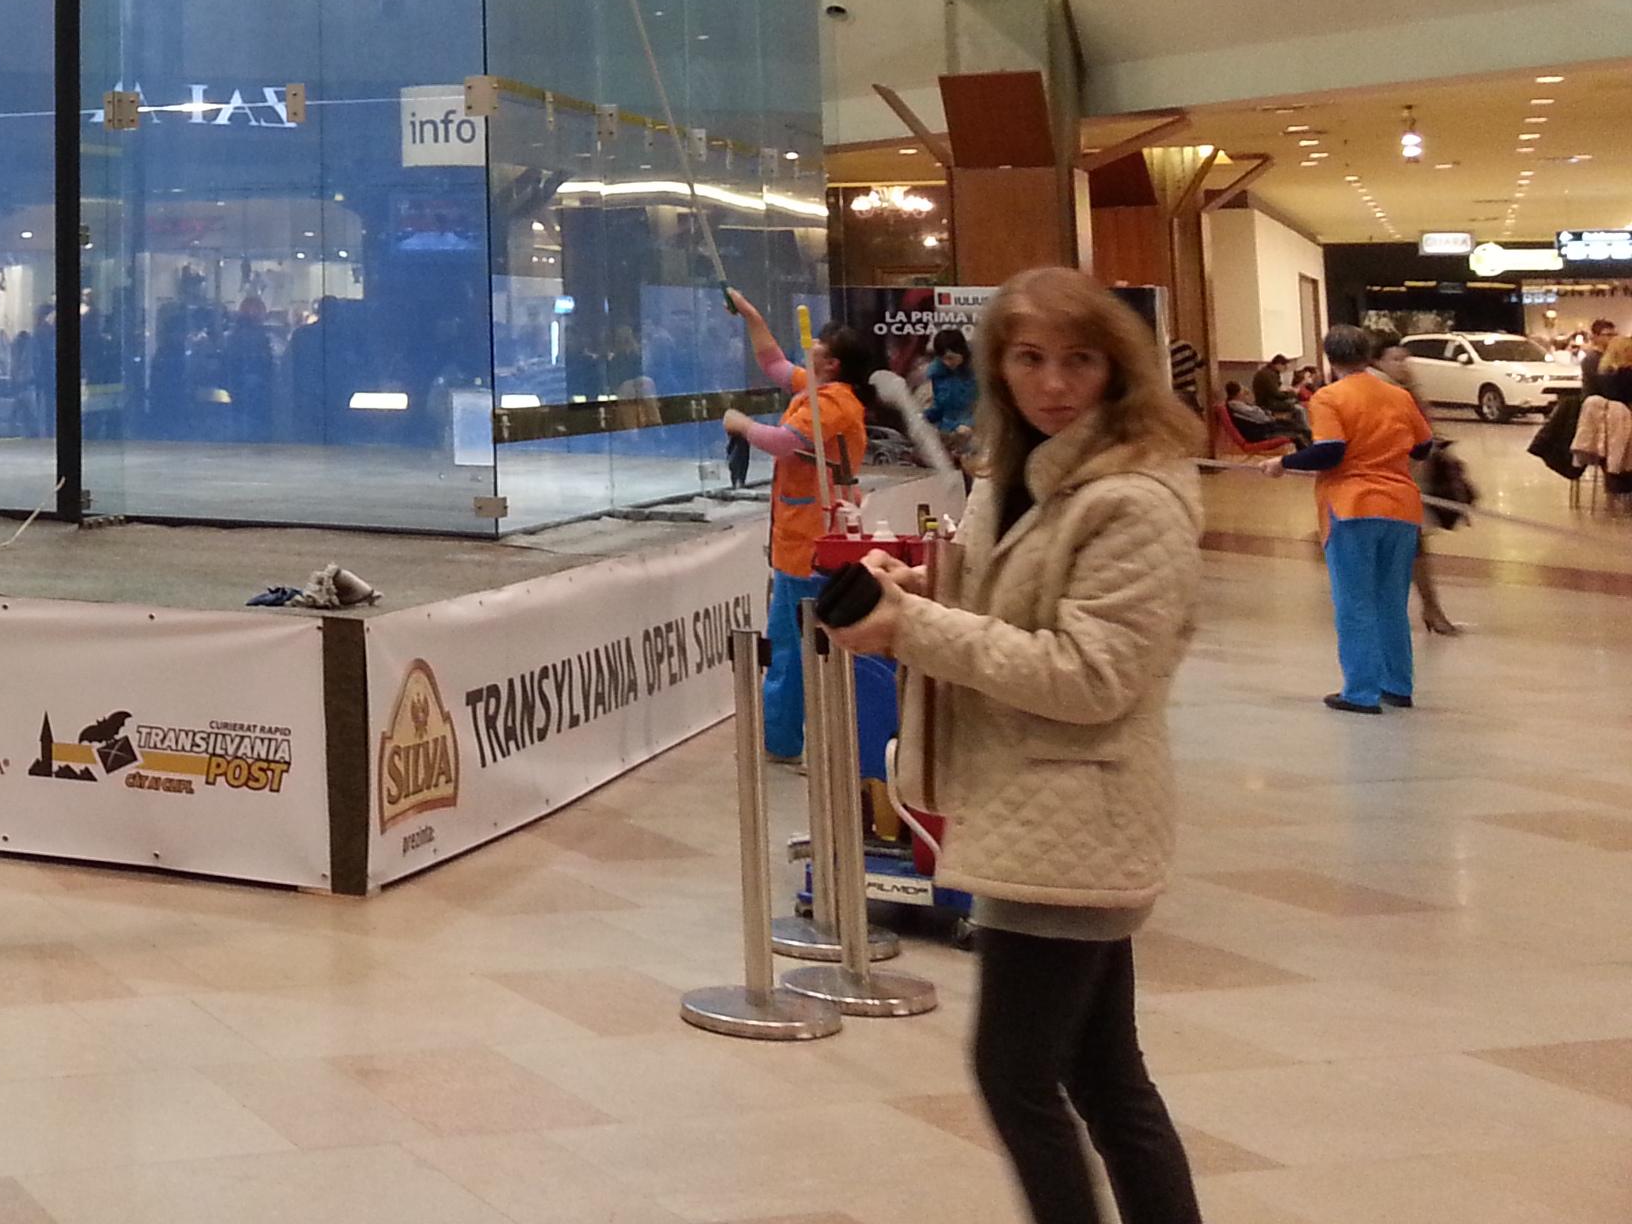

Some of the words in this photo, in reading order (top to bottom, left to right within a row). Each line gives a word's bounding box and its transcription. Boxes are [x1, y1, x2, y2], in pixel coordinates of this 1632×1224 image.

[410, 109, 476, 144] info
[873, 323, 888, 335] O
[885, 311, 907, 323] LA
[911, 311, 968, 323] PRIMA
[466, 636, 638, 768] TRANSYLVANIA
[642, 617, 689, 696] OPEN
[136, 724, 292, 764] TRANSILVANIA
[209, 720, 258, 733] CURIERAT
[259, 725, 292, 737] RAPID
[205, 755, 292, 794] POST
[386, 734, 453, 805] SILVA
